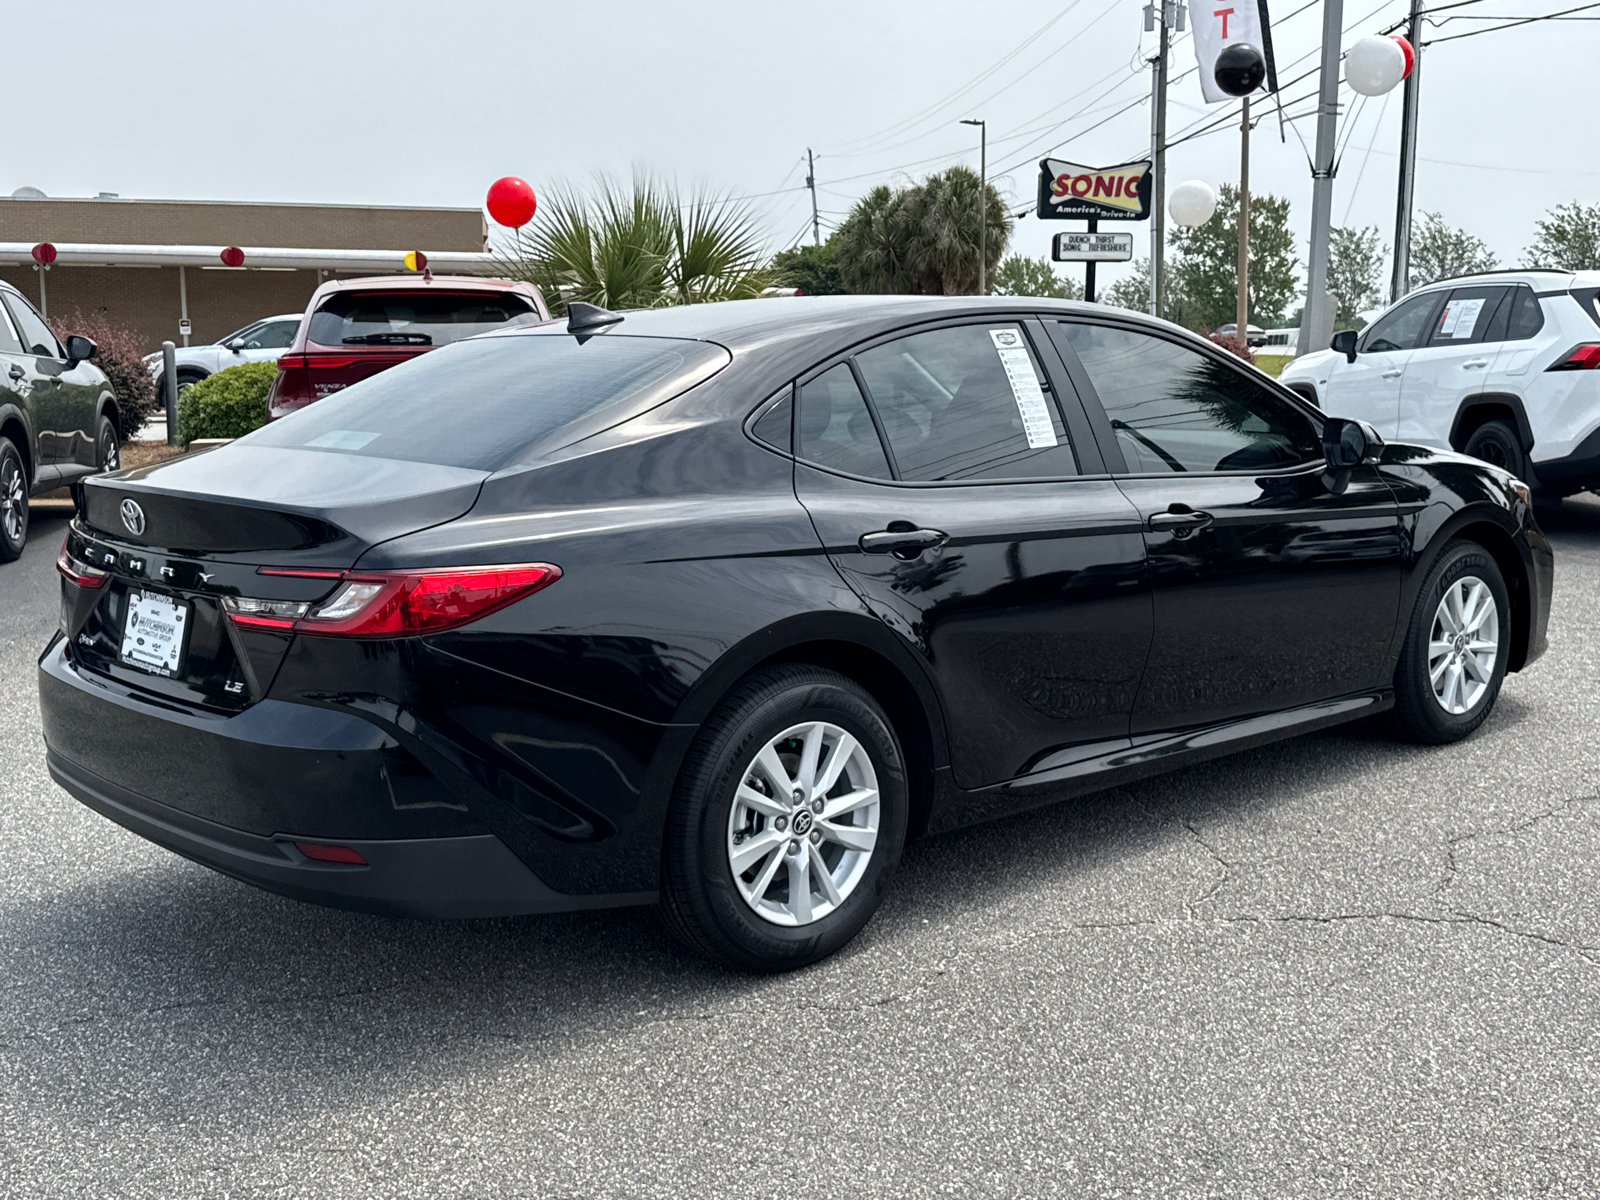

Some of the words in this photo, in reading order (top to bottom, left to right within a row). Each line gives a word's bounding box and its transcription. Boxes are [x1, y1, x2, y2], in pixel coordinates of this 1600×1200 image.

[1053, 173, 1141, 198] SONIC
[1056, 205, 1101, 214] America's
[1101, 210, 1136, 218] Drive-In
[1068, 235, 1090, 243] QUENCH
[1095, 235, 1115, 243] THIRST
[1063, 243, 1081, 251] SONIC
[1089, 243, 1127, 251] REFRESHERS
[85, 548, 216, 582] CAMRY
[224, 680, 244, 693] LE
